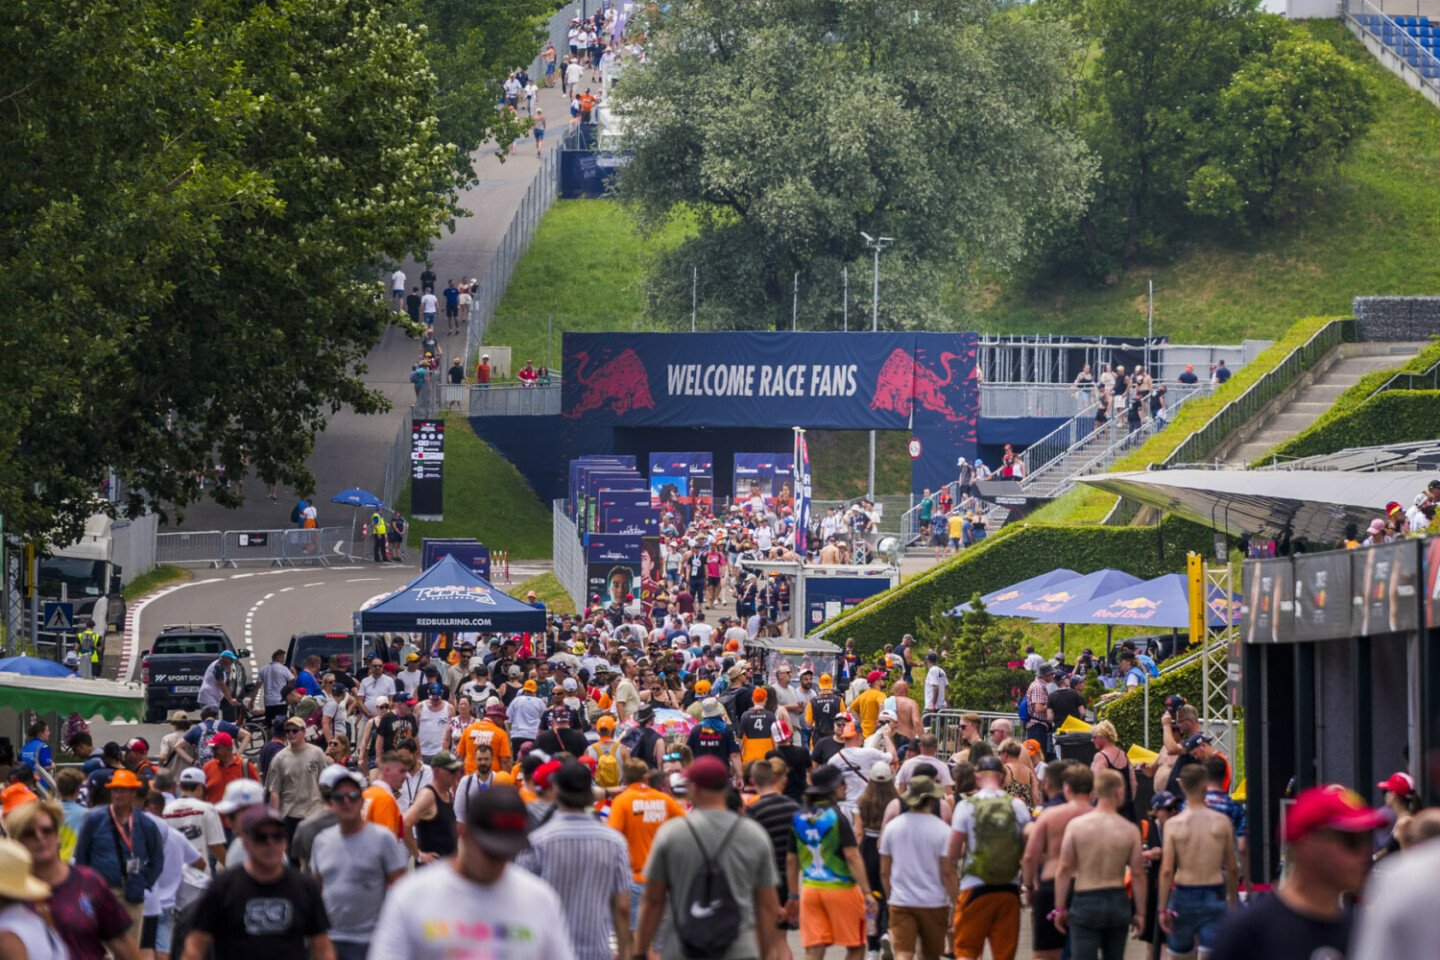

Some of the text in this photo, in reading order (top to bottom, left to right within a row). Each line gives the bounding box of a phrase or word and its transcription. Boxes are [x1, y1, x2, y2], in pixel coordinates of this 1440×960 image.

[667, 364, 858, 396] WELCOME RACE FANS
[1091, 608, 1156, 619] Red Bull
[416, 618, 492, 626] REDBULLRING.COM
[822, 703, 830, 714] 4
[753, 718, 764, 731] 4
[632, 799, 666, 811] ORANGE
[642, 810, 667, 823] ARMY
